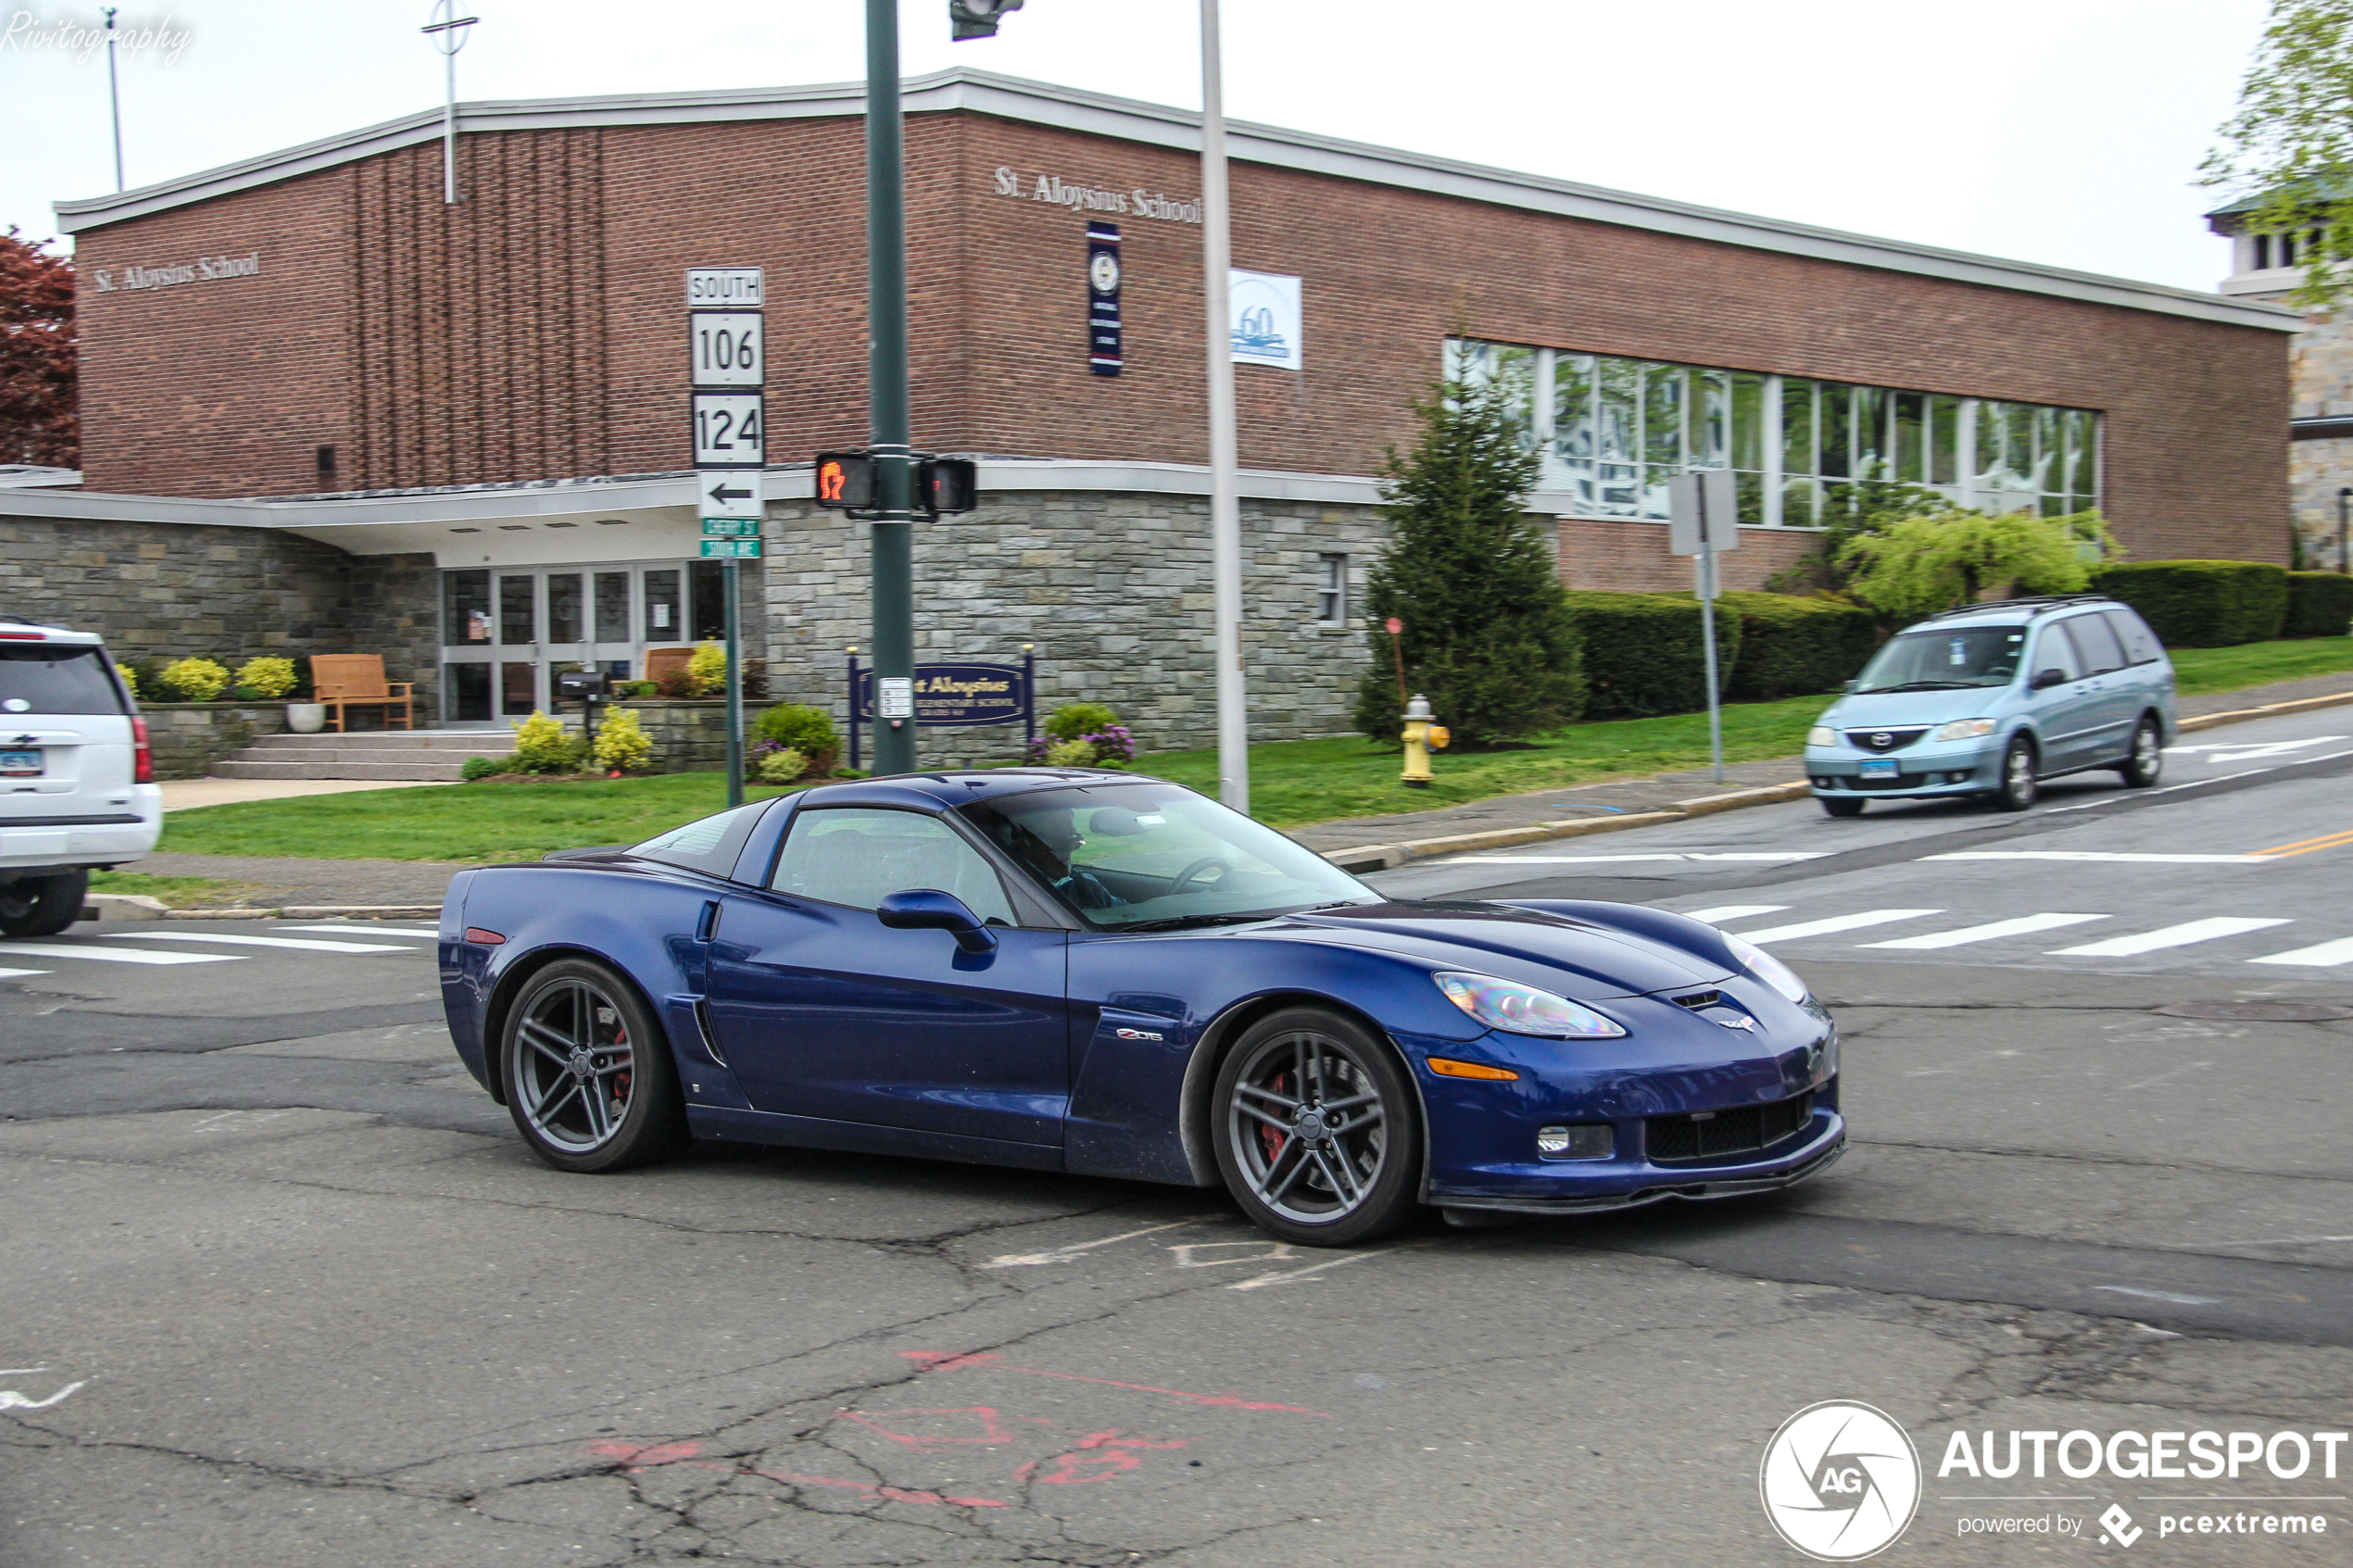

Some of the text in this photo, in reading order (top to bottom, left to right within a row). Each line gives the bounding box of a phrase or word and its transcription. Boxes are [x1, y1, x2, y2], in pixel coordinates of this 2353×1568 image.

[995, 167, 1202, 224] St. Aloysius School
[122, 263, 196, 292] Aloysius
[199, 252, 260, 281] School
[690, 277, 759, 297] SOUTH
[1239, 306, 1274, 339] 60
[699, 329, 754, 370] 106
[695, 408, 761, 450] 124
[707, 520, 740, 534] CHERRY
[927, 676, 1010, 698] Aloysius
[915, 697, 1016, 708] ELEMENTARY SCHOOL
[1116, 1027, 1164, 1042] Z06
